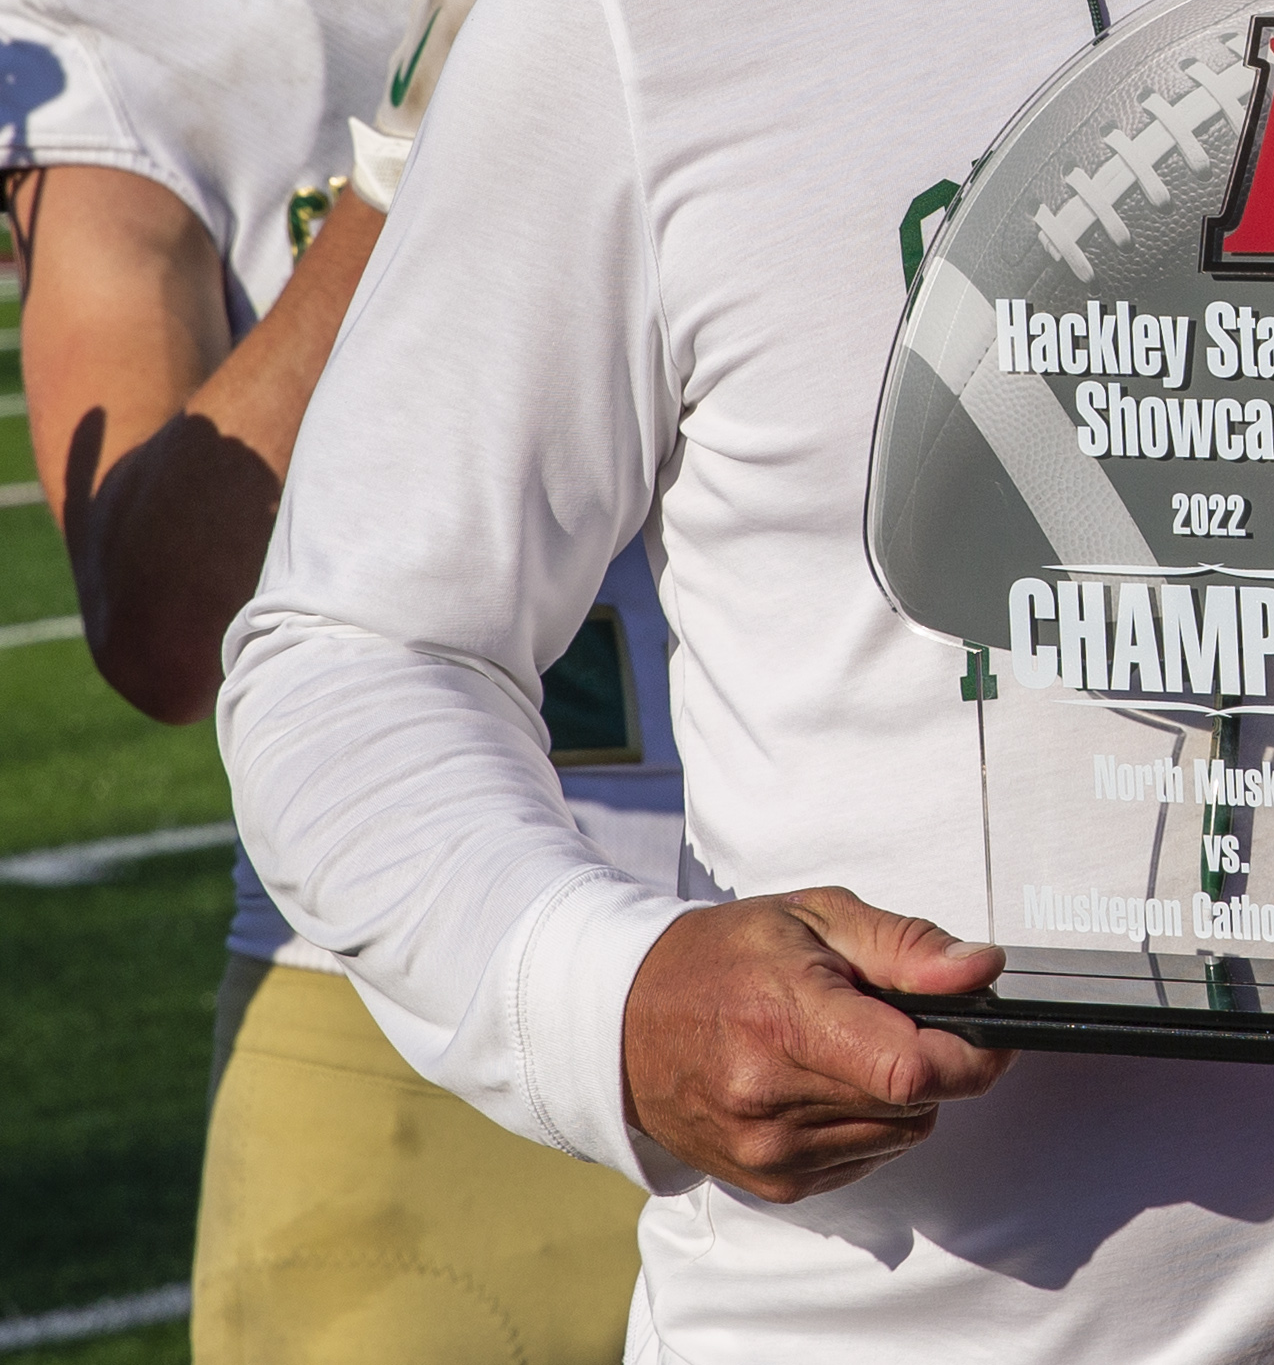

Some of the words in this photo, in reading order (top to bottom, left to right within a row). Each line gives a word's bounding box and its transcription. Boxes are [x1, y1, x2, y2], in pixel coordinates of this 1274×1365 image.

[995, 298, 1190, 389] Hackley
[1171, 493, 1247, 538] 2022
[1092, 754, 1184, 804] North
[1203, 834, 1251, 874] vs.
[1022, 884, 1183, 942] Muskegon
